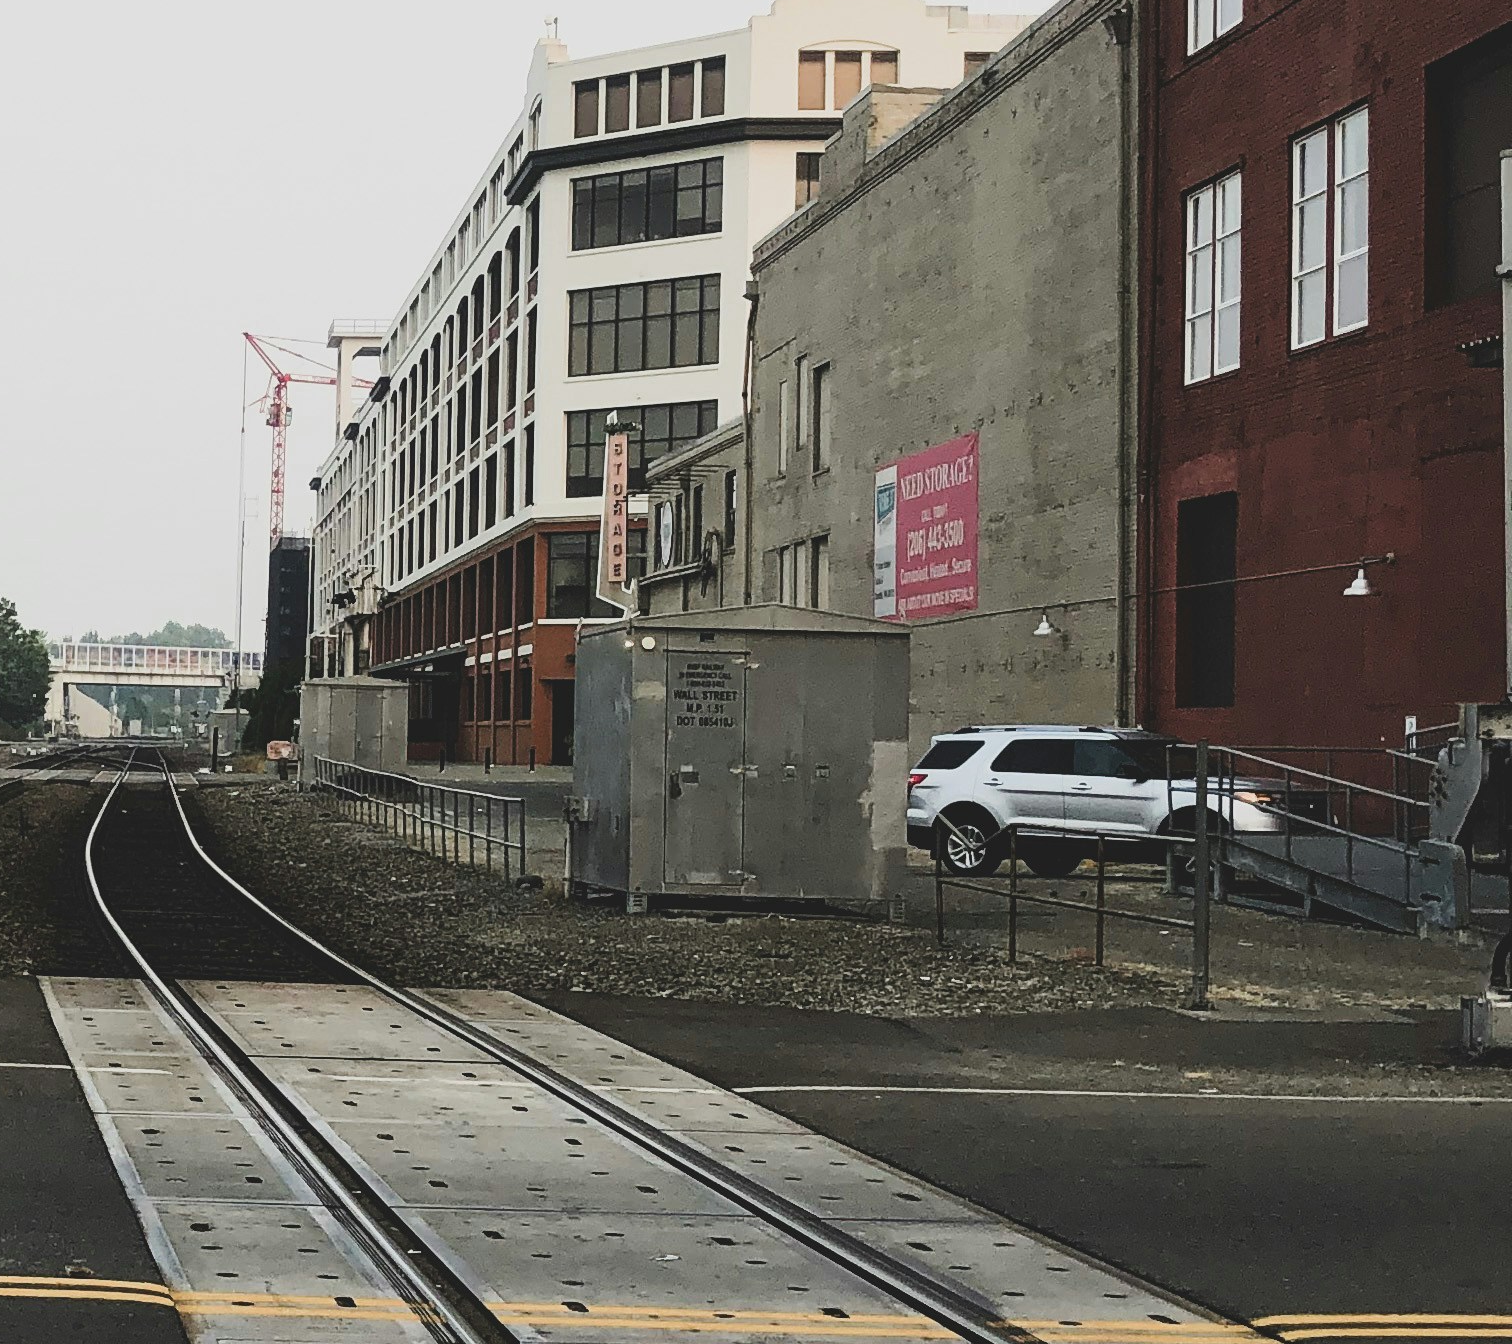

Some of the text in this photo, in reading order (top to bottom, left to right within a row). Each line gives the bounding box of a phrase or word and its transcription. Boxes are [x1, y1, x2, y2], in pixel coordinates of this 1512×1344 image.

[900, 472, 923, 501] NEED
[924, 454, 973, 494] STORAGE?
[613, 443, 623, 577] STORAGE
[907, 528, 925, 562] (206)
[673, 690, 738, 701] WALL STREET
[676, 716, 695, 726] DOT
